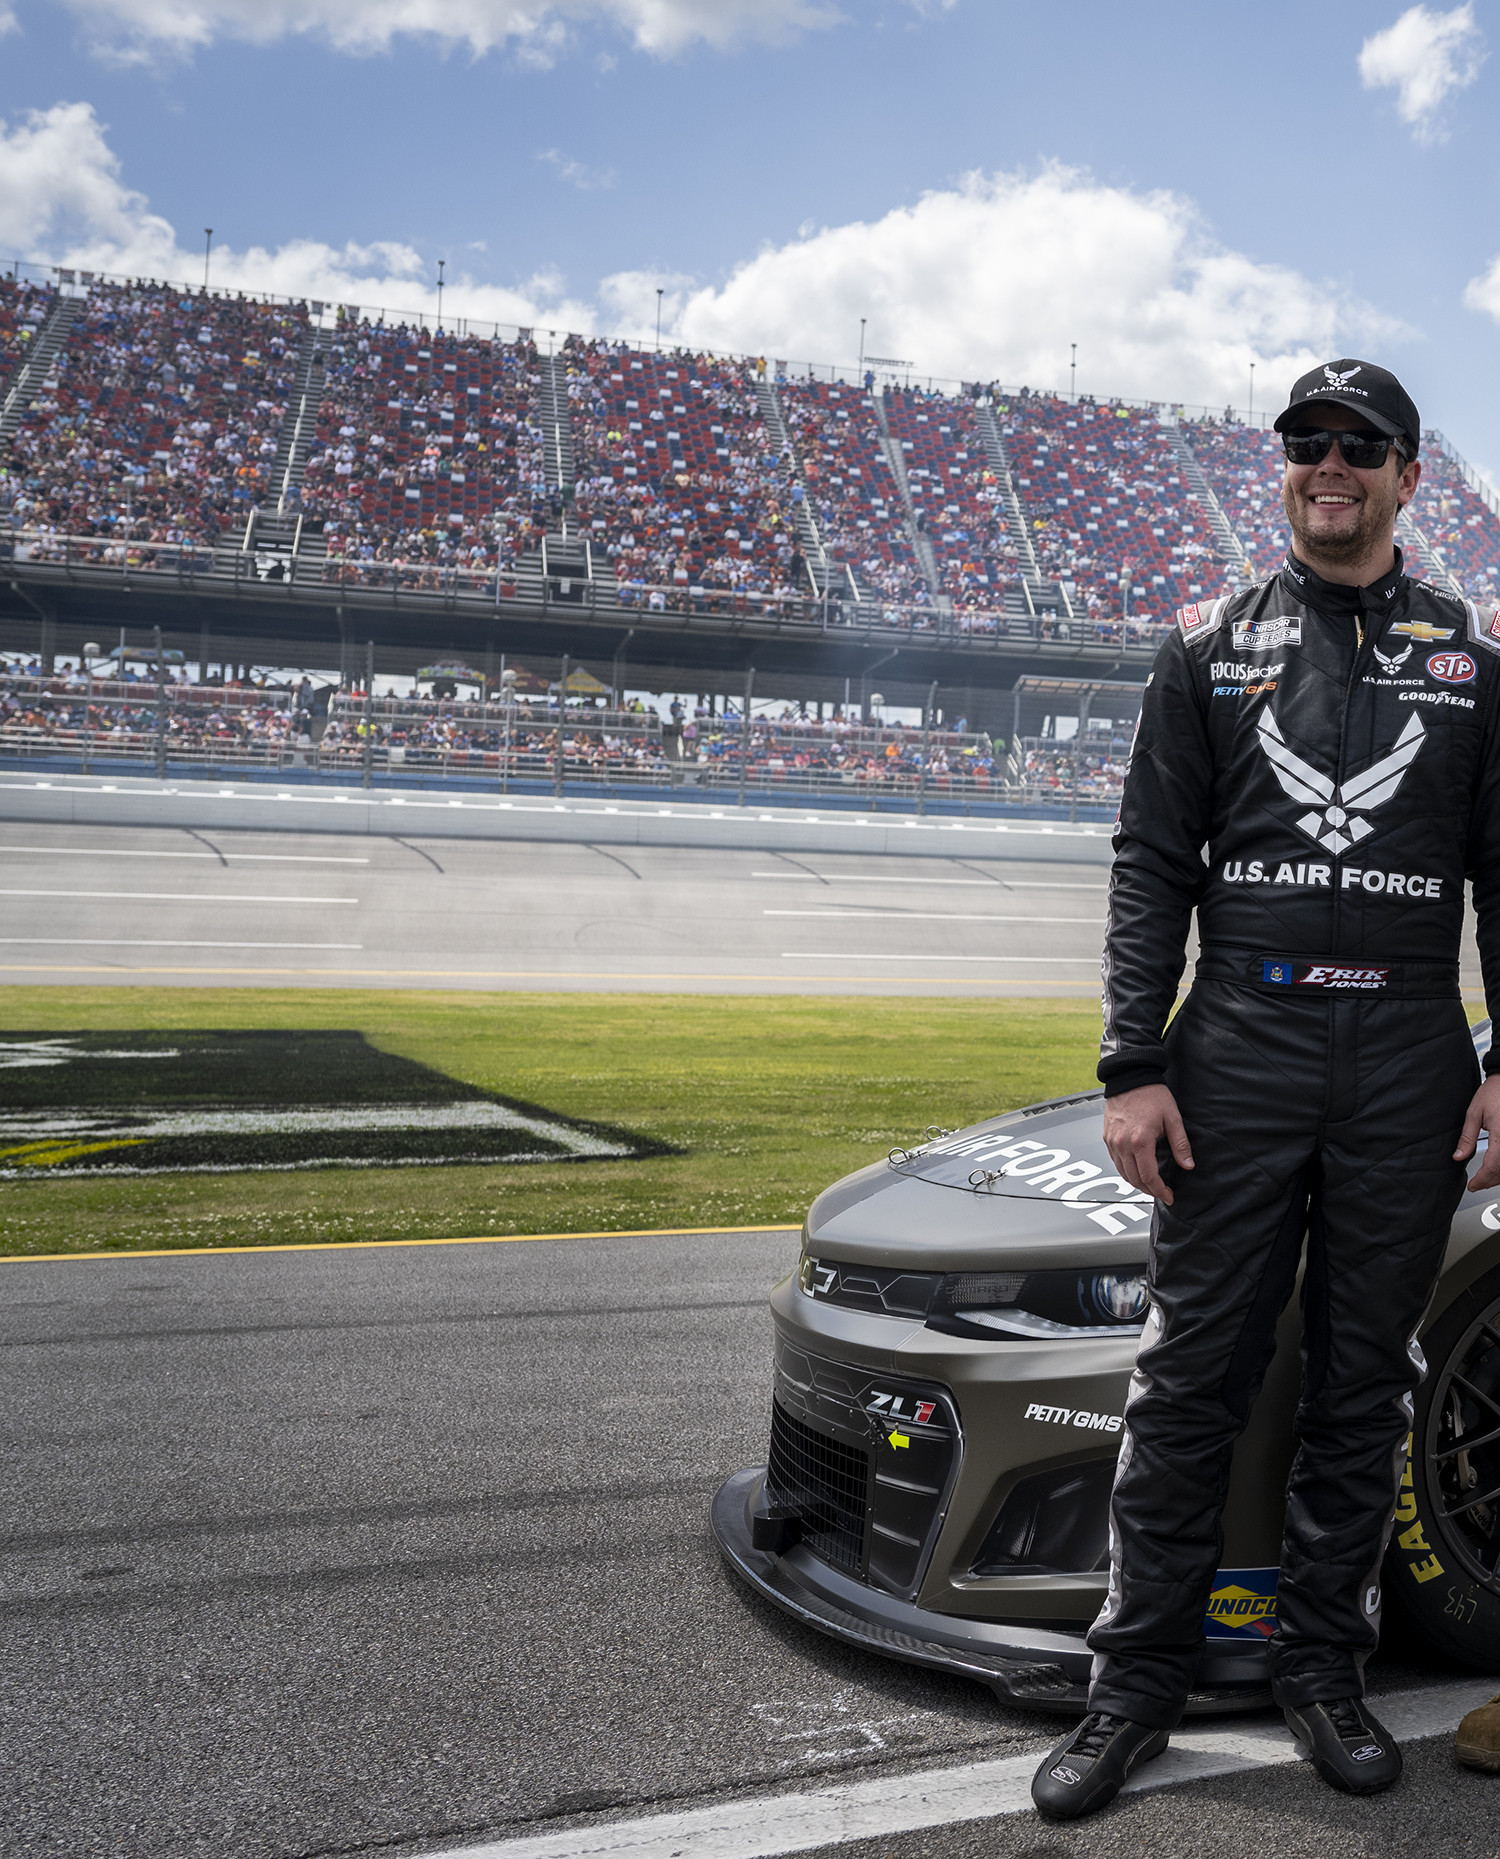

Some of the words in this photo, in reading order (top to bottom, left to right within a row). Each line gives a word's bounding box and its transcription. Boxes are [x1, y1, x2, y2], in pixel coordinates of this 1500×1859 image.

[1337, 386, 1369, 397] FORCE
[1255, 619, 1291, 633] NASCAR
[1243, 633, 1261, 645] CUP
[1433, 655, 1472, 677] STP
[1398, 691, 1476, 709] GOODYEAR
[1223, 862, 1270, 883] U.S.
[1275, 864, 1329, 886] AIR
[1341, 868, 1443, 898] FORCE
[1299, 966, 1389, 983] ERIK
[1323, 980, 1380, 989] JONES
[974, 1140, 1155, 1236] FORCE
[866, 1391, 936, 1424] ZL1
[1024, 1403, 1076, 1425] PETTY
[1073, 1412, 1123, 1433] GMS
